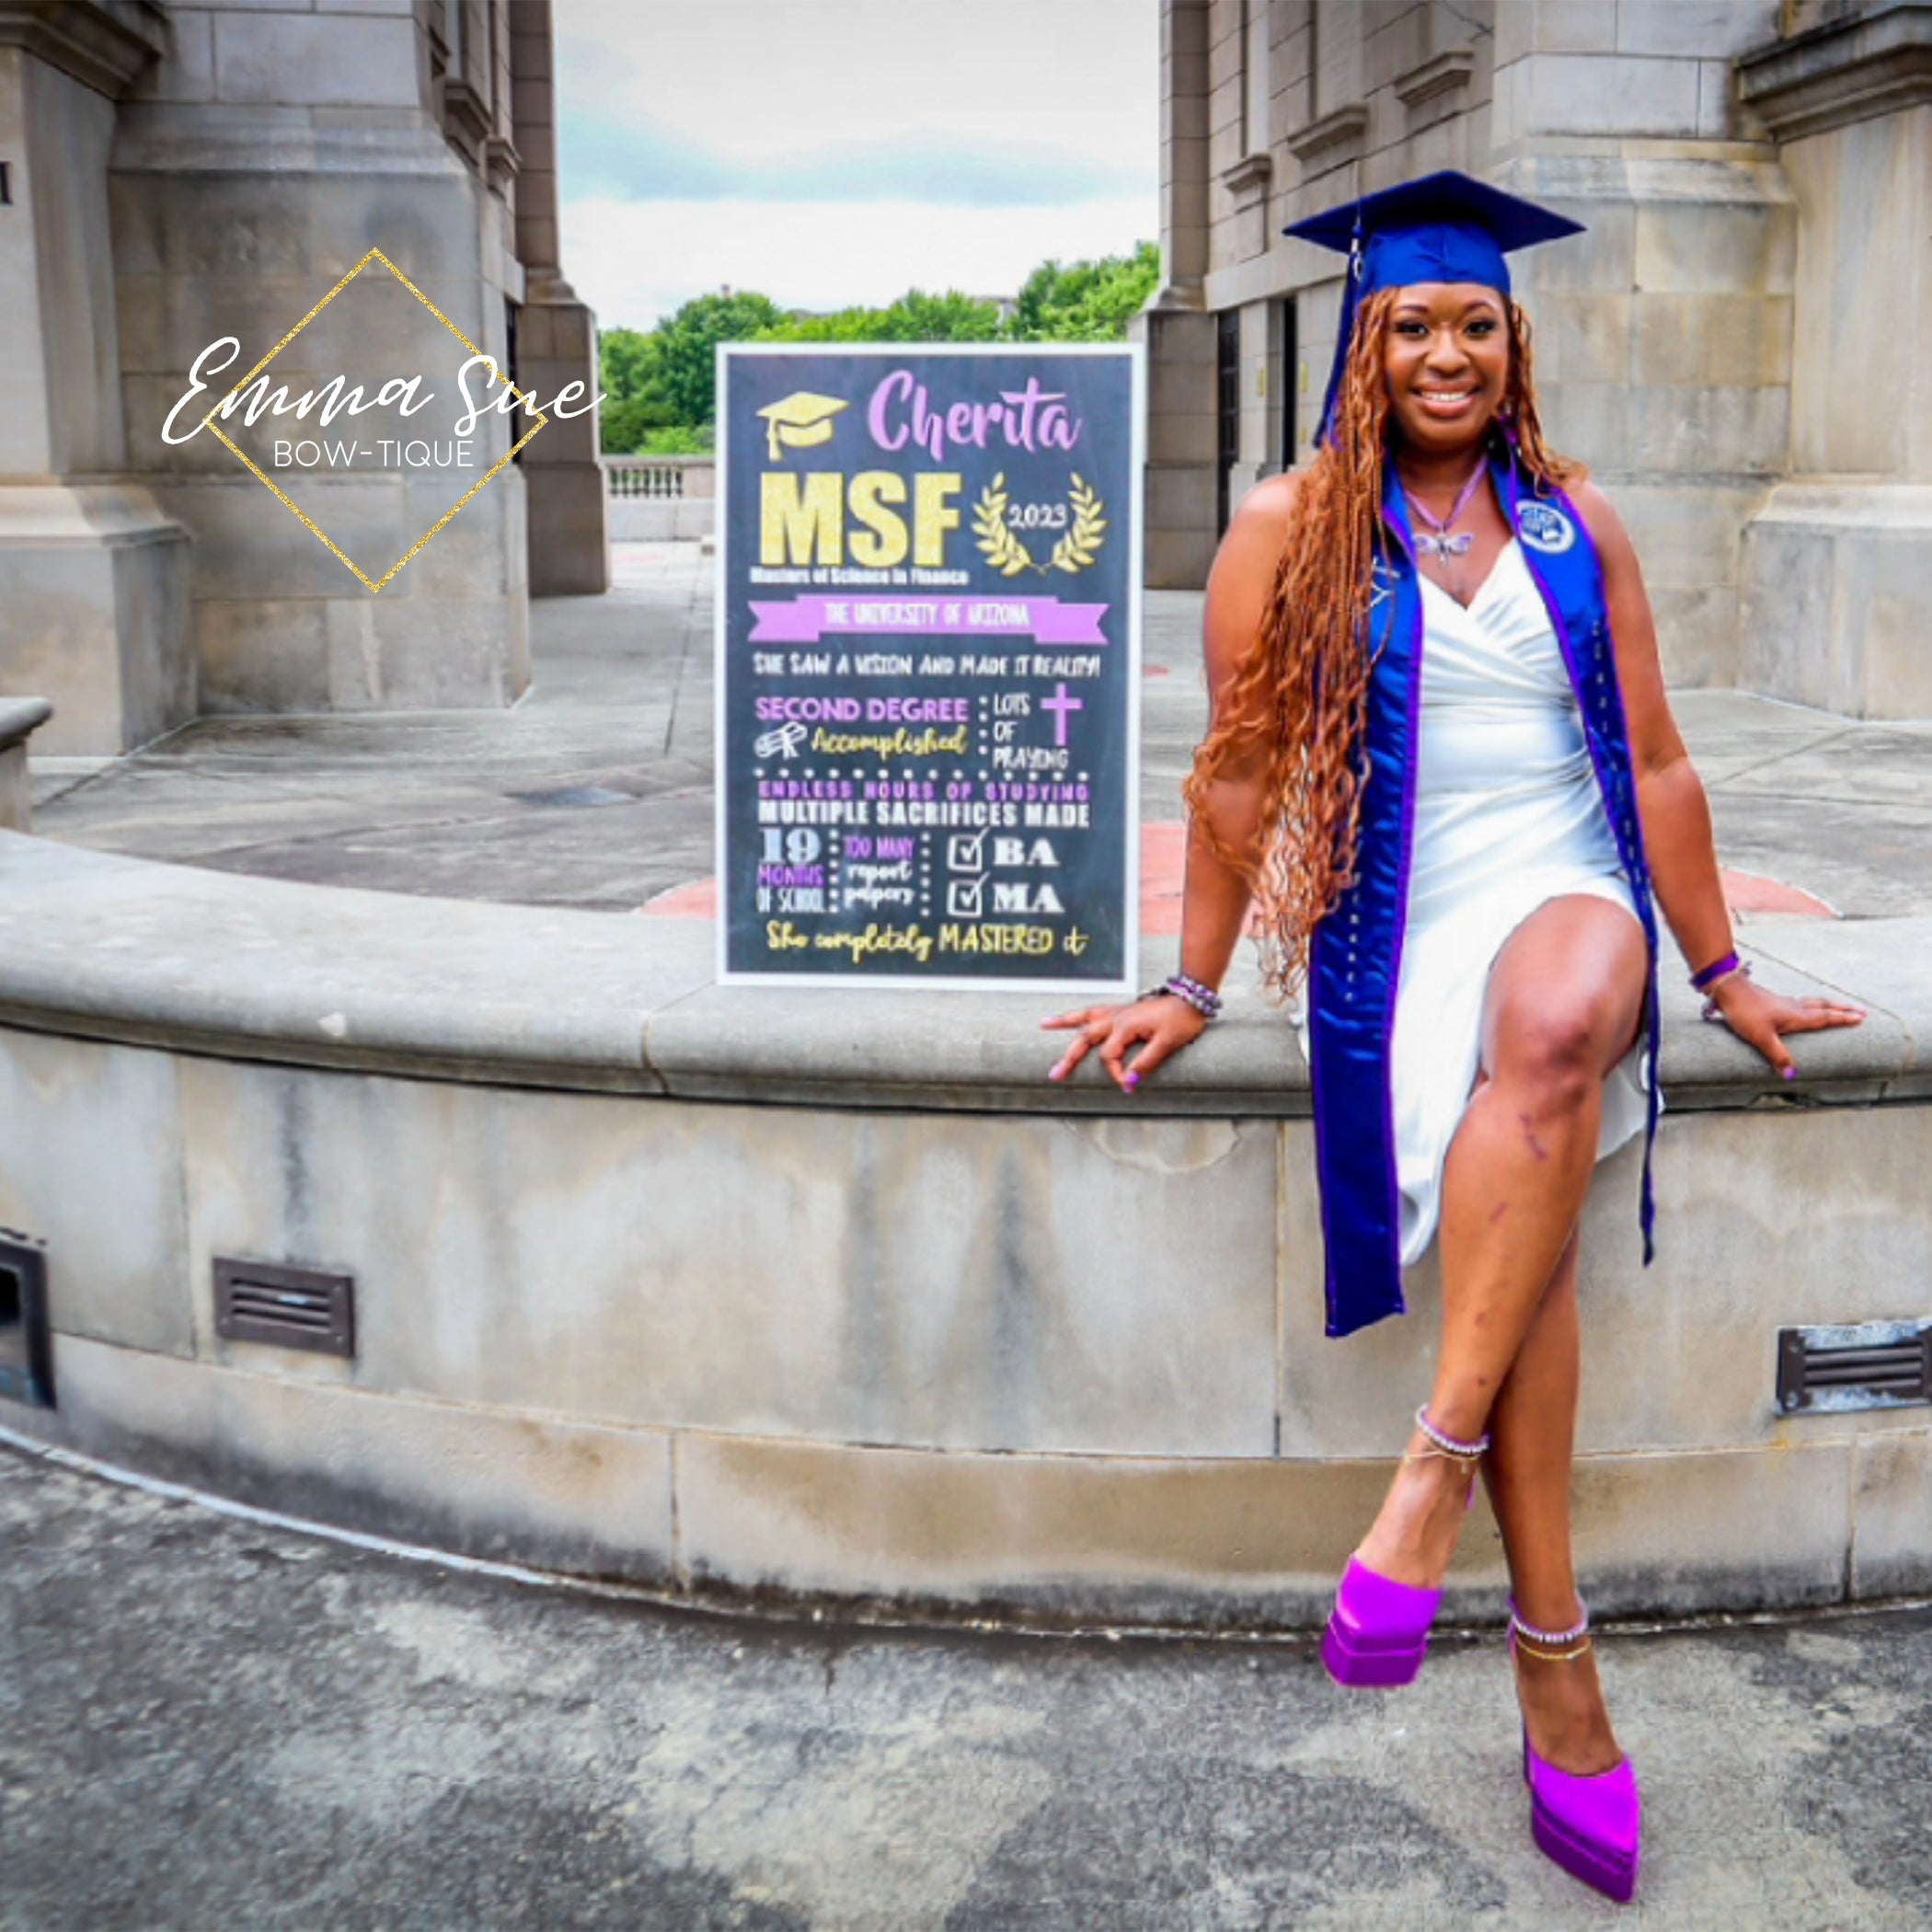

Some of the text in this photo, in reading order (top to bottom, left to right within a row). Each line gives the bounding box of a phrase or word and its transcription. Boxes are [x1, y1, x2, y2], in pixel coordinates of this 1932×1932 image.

[868, 369, 1083, 462] Cherita
[760, 470, 962, 567] MSF
[1008, 503, 1068, 529] 2023
[825, 603, 1030, 627] THE UNIVERSITY OF ARIZONA
[753, 653, 785, 674] SHE
[790, 653, 829, 675] SAW
[835, 653, 850, 675] A
[855, 654, 913, 676] VISION
[919, 654, 956, 676] AND
[960, 655, 1007, 676] MADE
[1014, 655, 1029, 676] IT
[754, 697, 970, 723] SECOND DEGREE
[993, 692, 1030, 717] LOTS
[811, 726, 969, 761] Accomplished
[993, 721, 1018, 742] OF
[993, 747, 1068, 770] PRAYING
[758, 779, 1090, 801] ENDLESS HOURS OF STUDYING
[758, 799, 1090, 828] MULTIPLE SACRIFICES MADE
[761, 827, 822, 865] 19
[877, 837, 915, 859] MANY
[993, 838, 1060, 867] BA
[846, 862, 913, 887] report
[993, 883, 1065, 914] MA
[766, 920, 1091, 963] She completely MASTERED it
